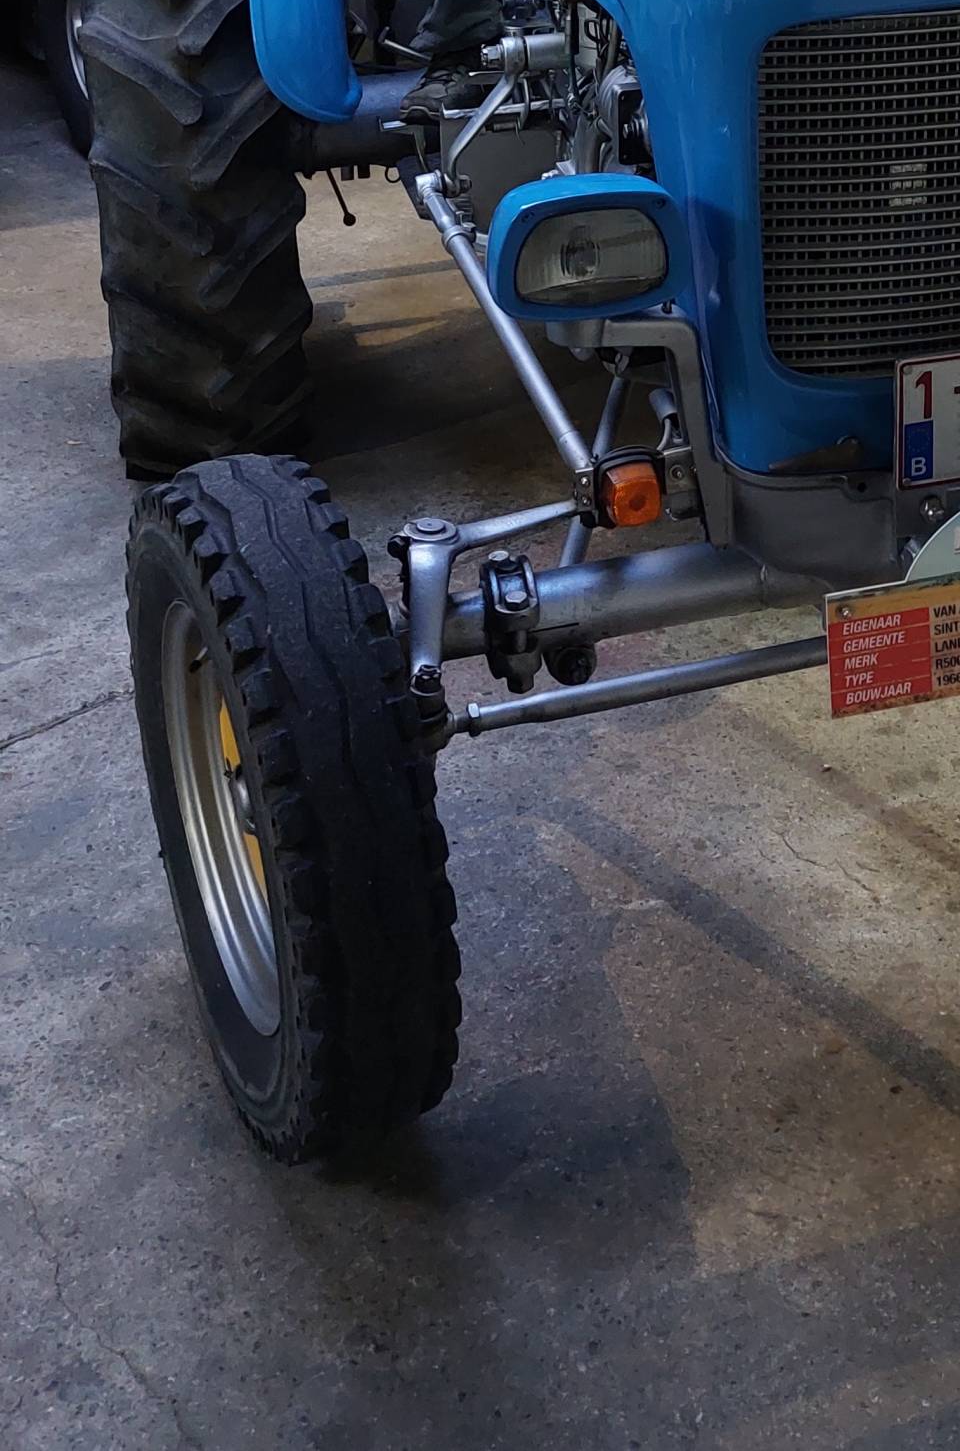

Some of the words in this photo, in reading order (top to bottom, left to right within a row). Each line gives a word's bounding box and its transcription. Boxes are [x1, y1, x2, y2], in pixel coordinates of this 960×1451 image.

[911, 456, 926, 476] B
[933, 604, 956, 618] VAN
[843, 614, 901, 636] EIGENAAR
[843, 631, 905, 653] GEMEENTE
[844, 653, 879, 670] MERK
[844, 671, 874, 688] TYPE
[846, 682, 912, 705] BOUWJAAR
